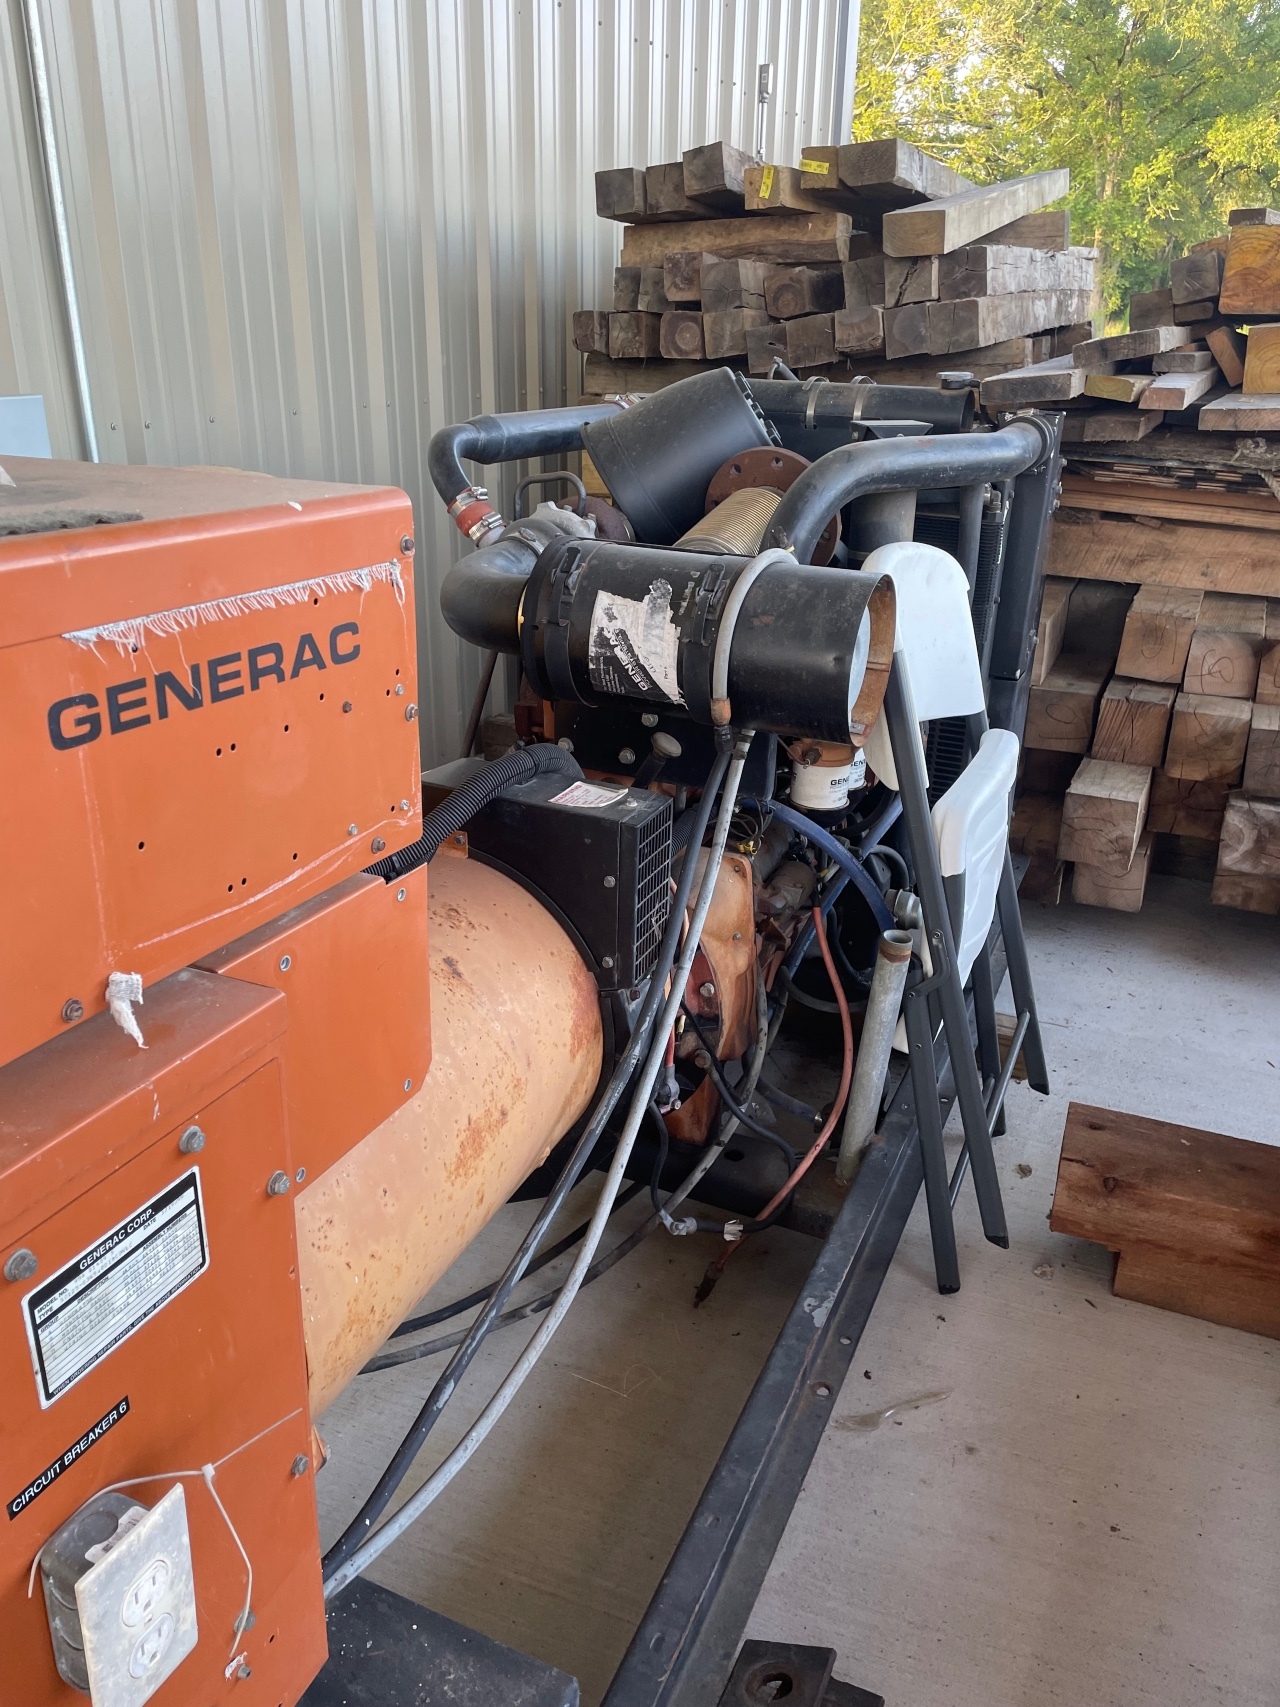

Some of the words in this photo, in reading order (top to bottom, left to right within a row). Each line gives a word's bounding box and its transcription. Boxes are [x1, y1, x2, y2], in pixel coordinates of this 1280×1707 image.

[47, 621, 361, 751] GENERAC
[143, 1216, 156, 1230] DATE
[79, 1230, 126, 1271] GENERAC
[127, 1208, 155, 1234] CORP.
[37, 1294, 57, 1314] MODEL
[58, 1286, 68, 1298] NO.
[38, 1305, 53, 1321] TYPE
[40, 1314, 59, 1333] GROUP
[12, 1461, 62, 1512] CIRCUIT
[63, 1410, 118, 1466] BREAKER
[119, 1401, 127, 1413] 6
